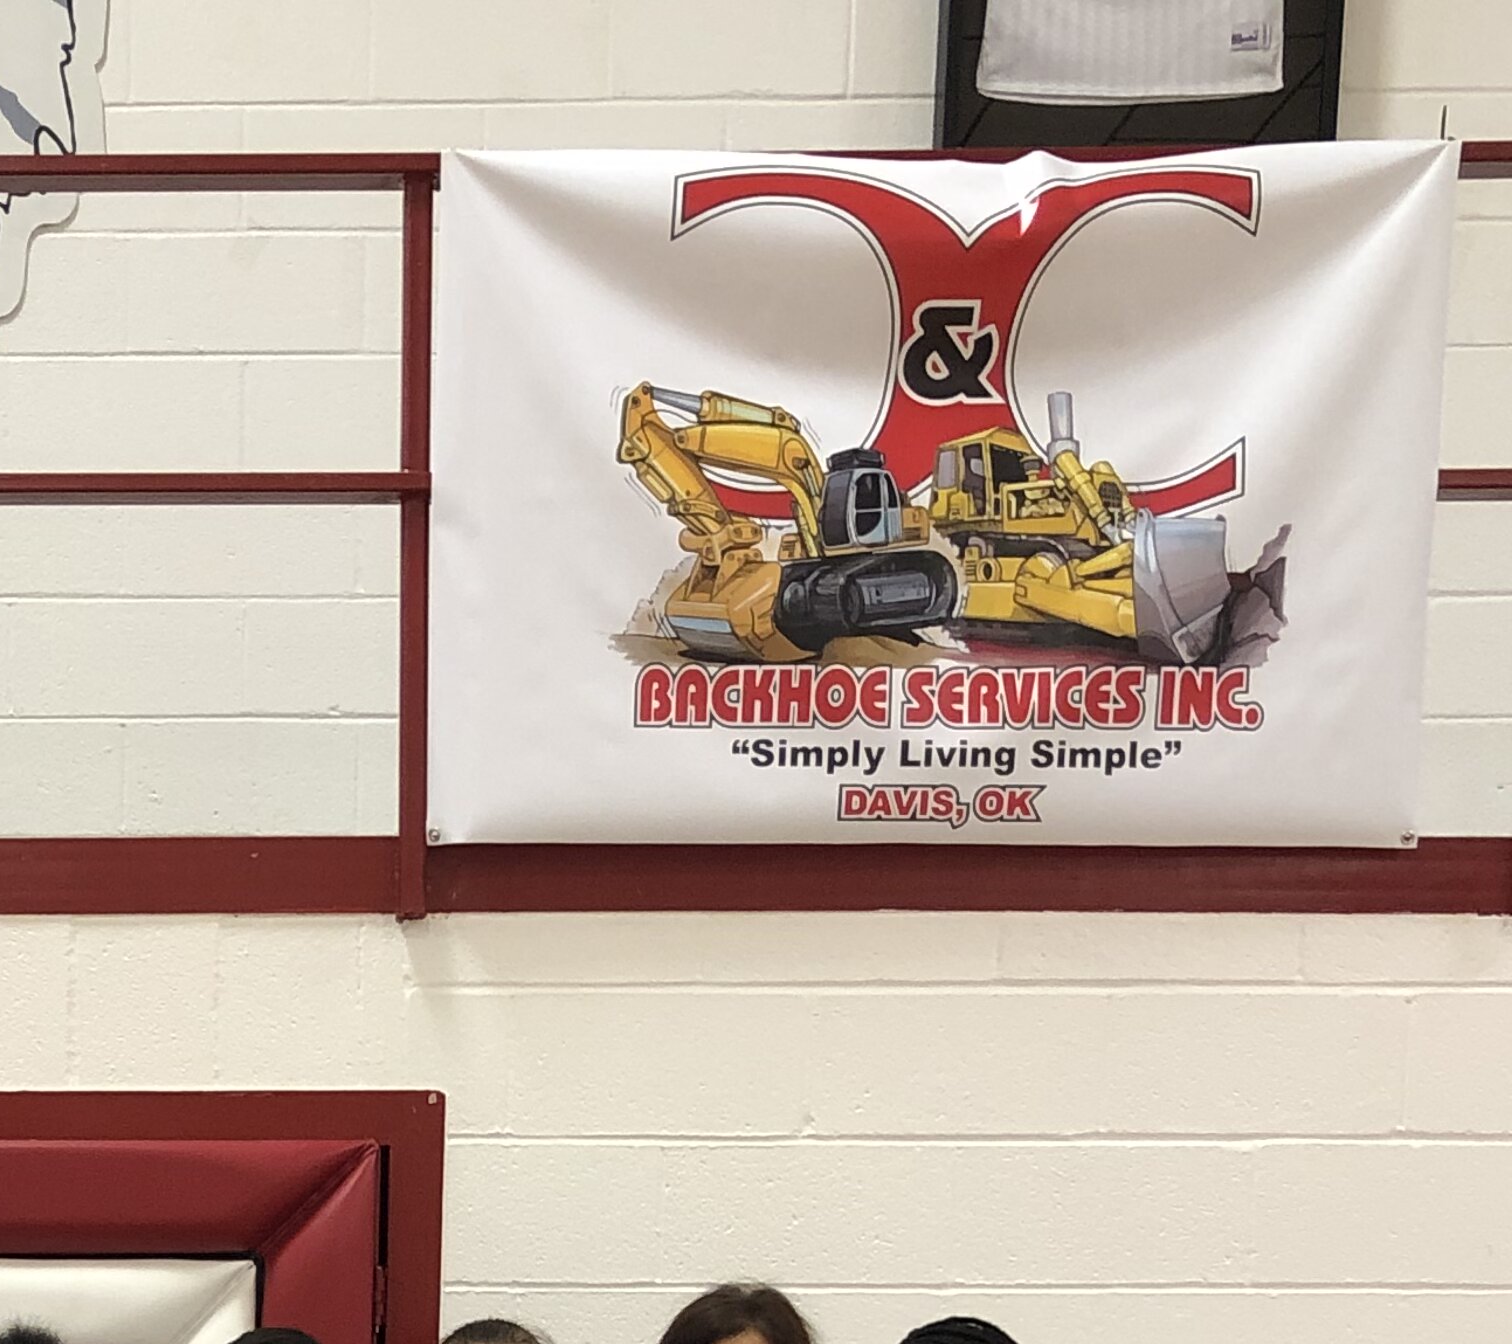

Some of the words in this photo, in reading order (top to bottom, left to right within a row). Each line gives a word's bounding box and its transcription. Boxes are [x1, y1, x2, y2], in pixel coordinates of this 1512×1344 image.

[634, 665, 892, 729] BACKHOE
[901, 665, 1147, 730] SERVICES
[1154, 665, 1265, 730] INC.
[900, 739, 1016, 775] Living
[837, 785, 969, 828] DAVIS,
[972, 785, 1046, 822] OK
